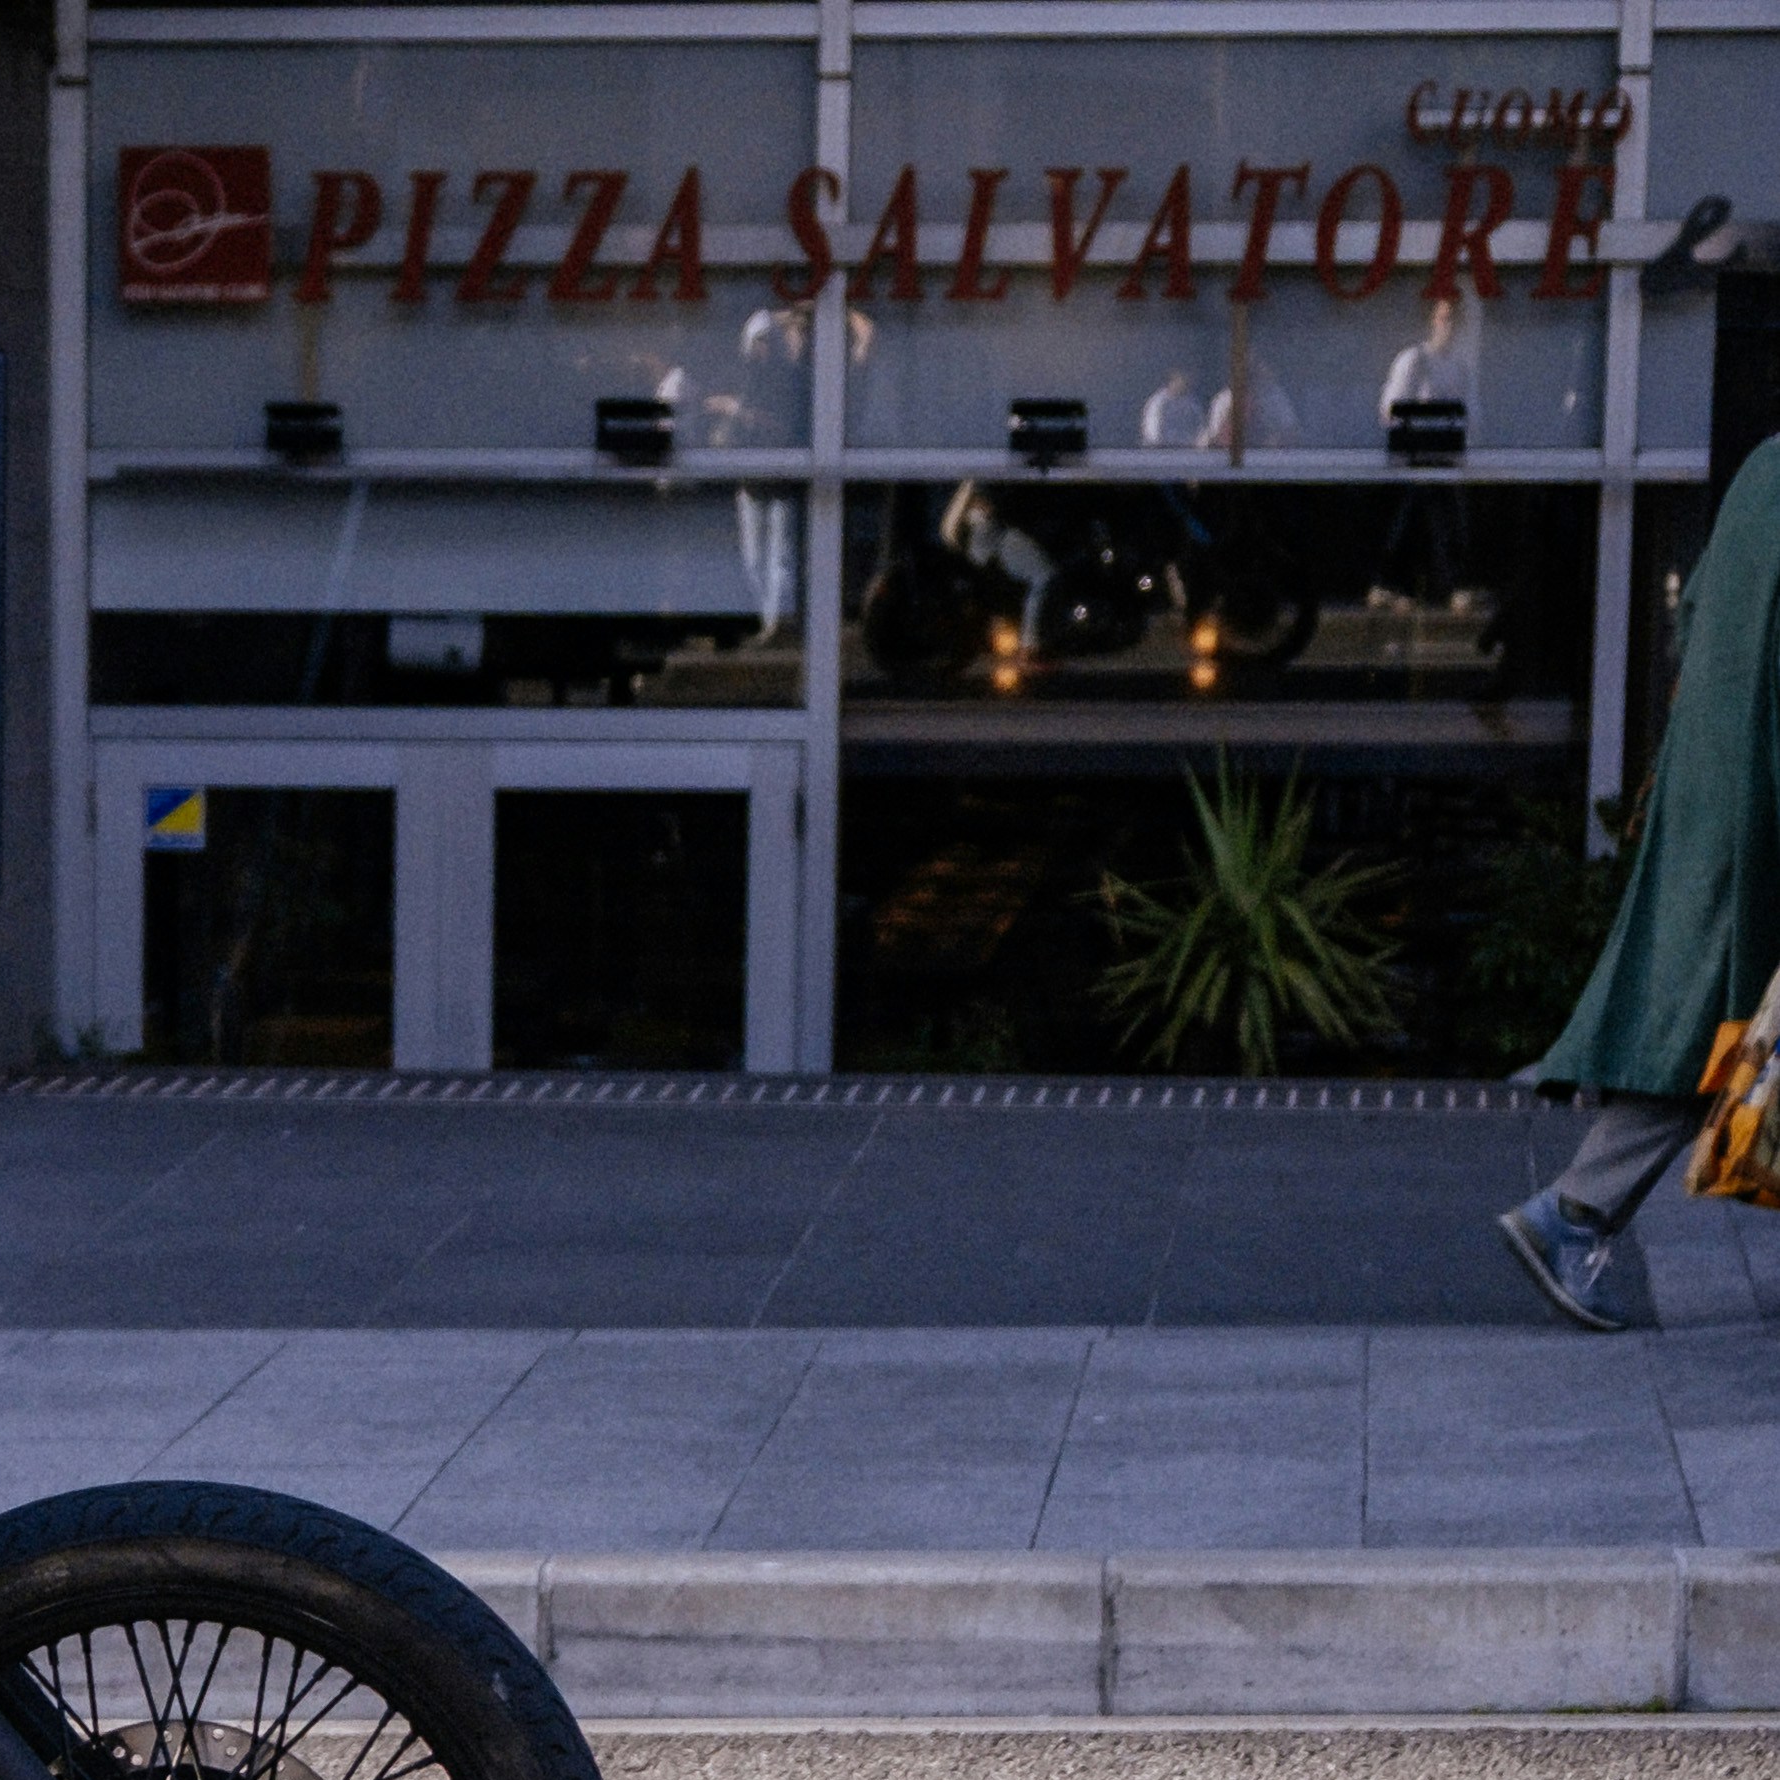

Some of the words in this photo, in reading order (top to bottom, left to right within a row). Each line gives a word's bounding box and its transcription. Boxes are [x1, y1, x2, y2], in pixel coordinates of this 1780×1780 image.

[1405, 79, 1633, 151] CUOMO
[293, 165, 710, 305] PIZZA
[770, 160, 1621, 305] SALVATORE
